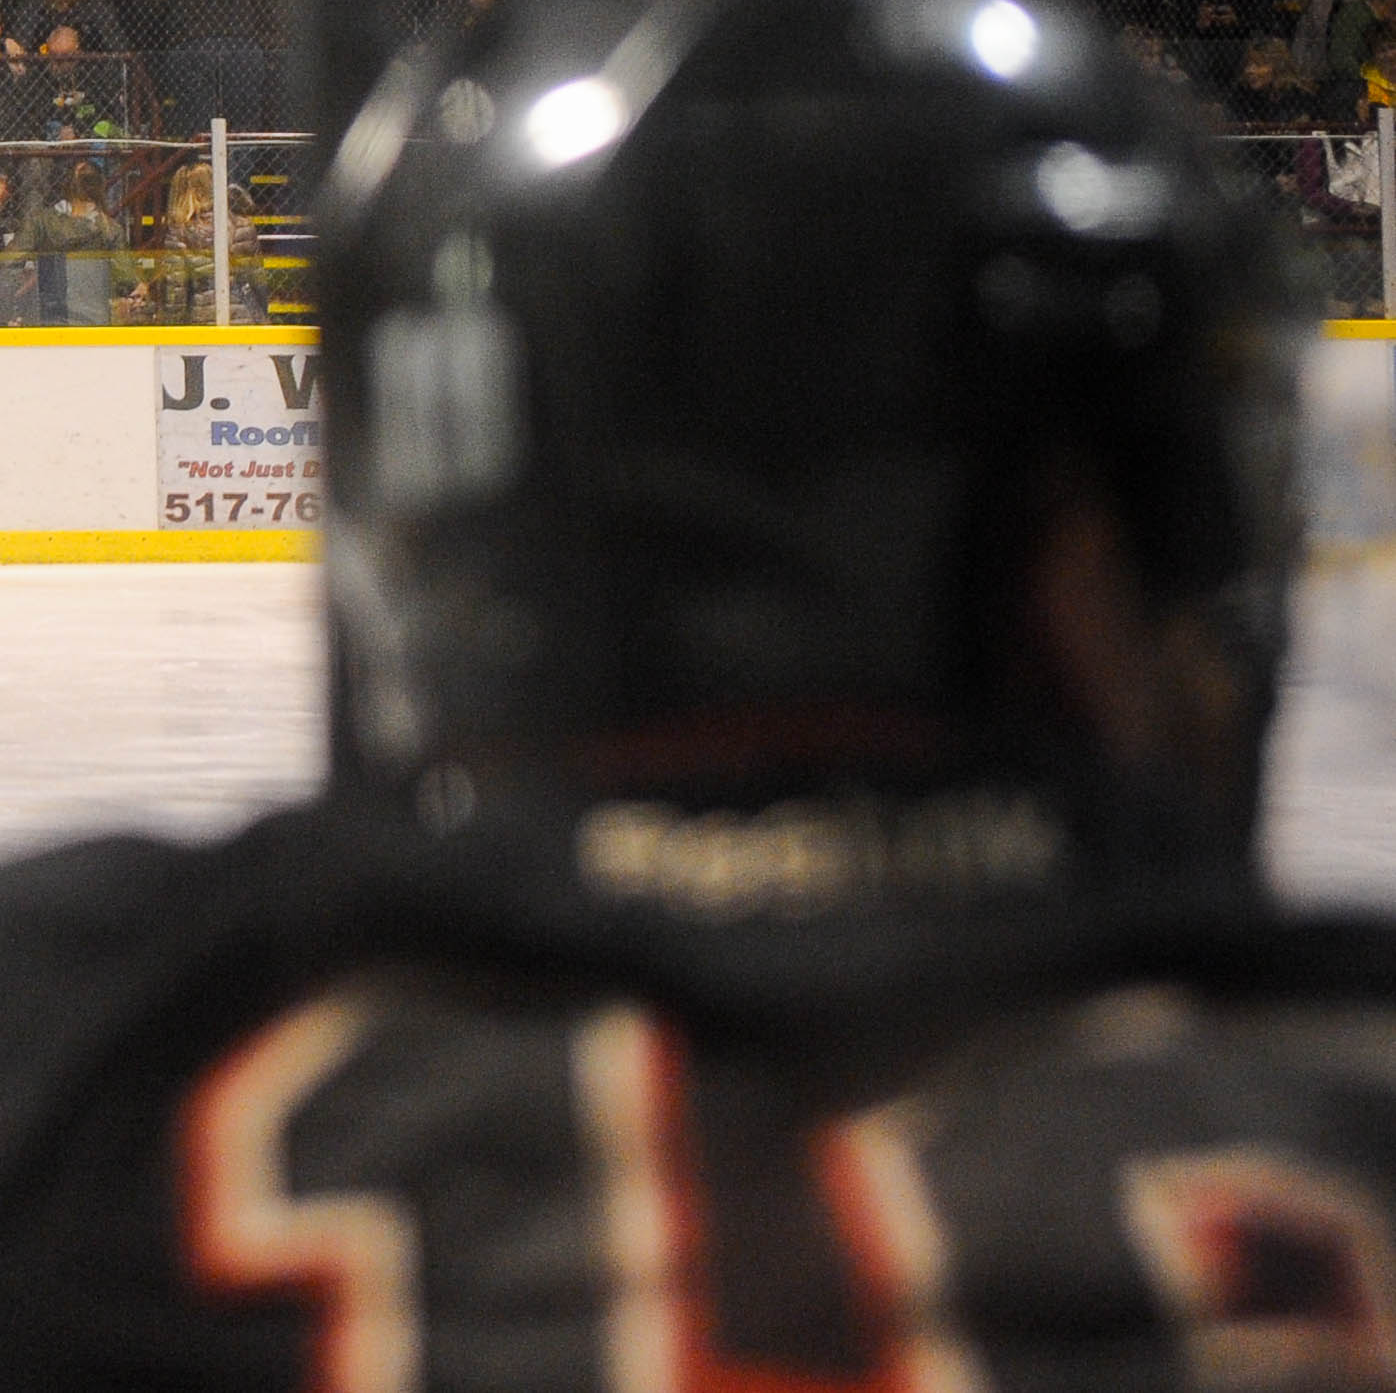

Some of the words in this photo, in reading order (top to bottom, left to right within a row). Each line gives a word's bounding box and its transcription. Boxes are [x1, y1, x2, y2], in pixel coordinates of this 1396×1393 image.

[162, 355, 230, 410] J.
[178, 461, 234, 478] "Not
[240, 460, 295, 478] Just
